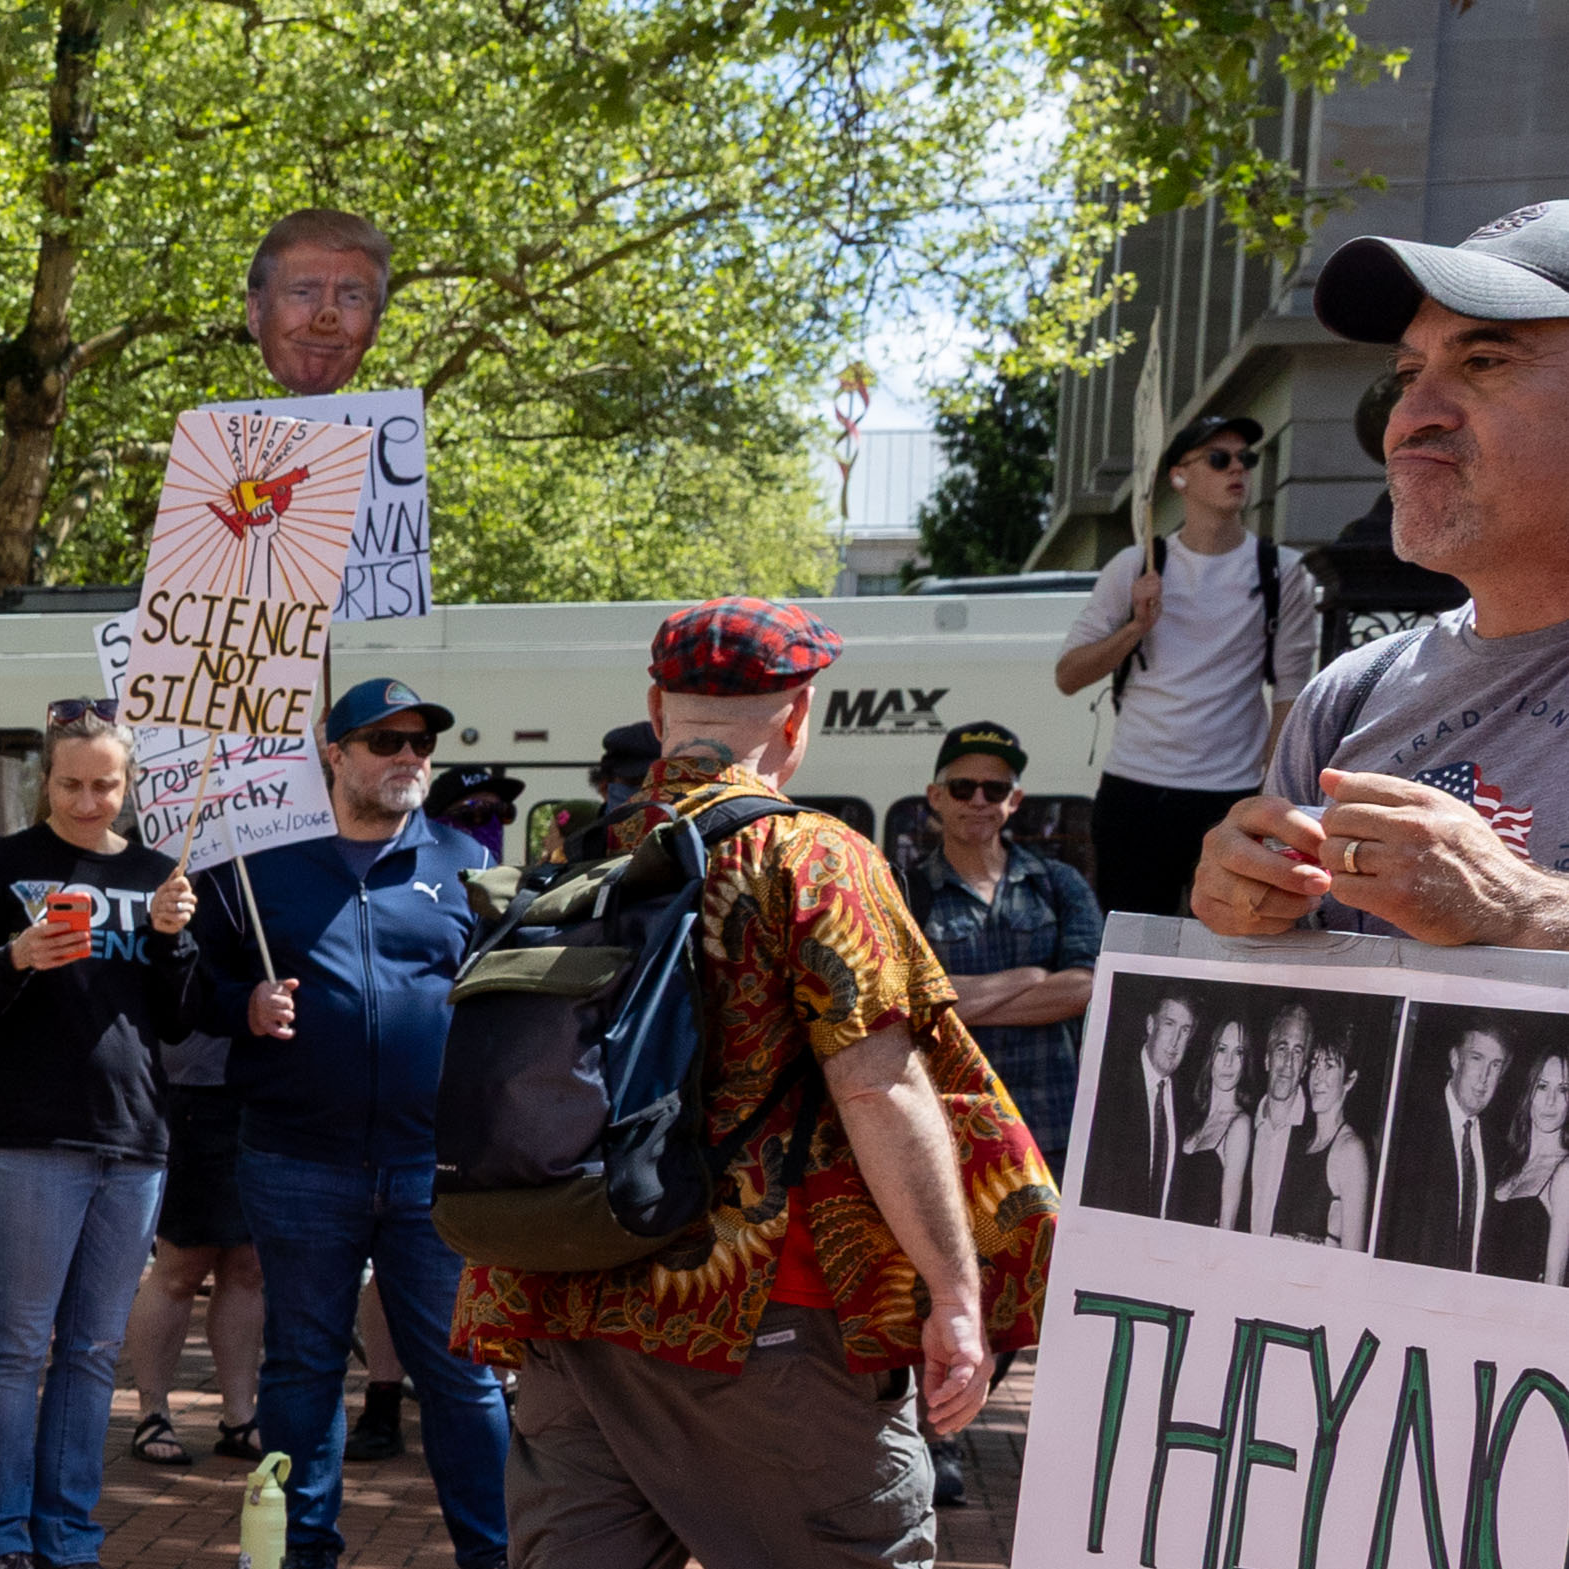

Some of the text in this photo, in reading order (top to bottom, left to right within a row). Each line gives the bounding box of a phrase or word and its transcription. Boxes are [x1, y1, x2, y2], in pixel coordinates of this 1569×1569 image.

[141, 589, 330, 660] SCIENCE
[193, 648, 267, 685] NOT
[124, 674, 312, 735] SILENCE
[823, 688, 950, 728] MAX
